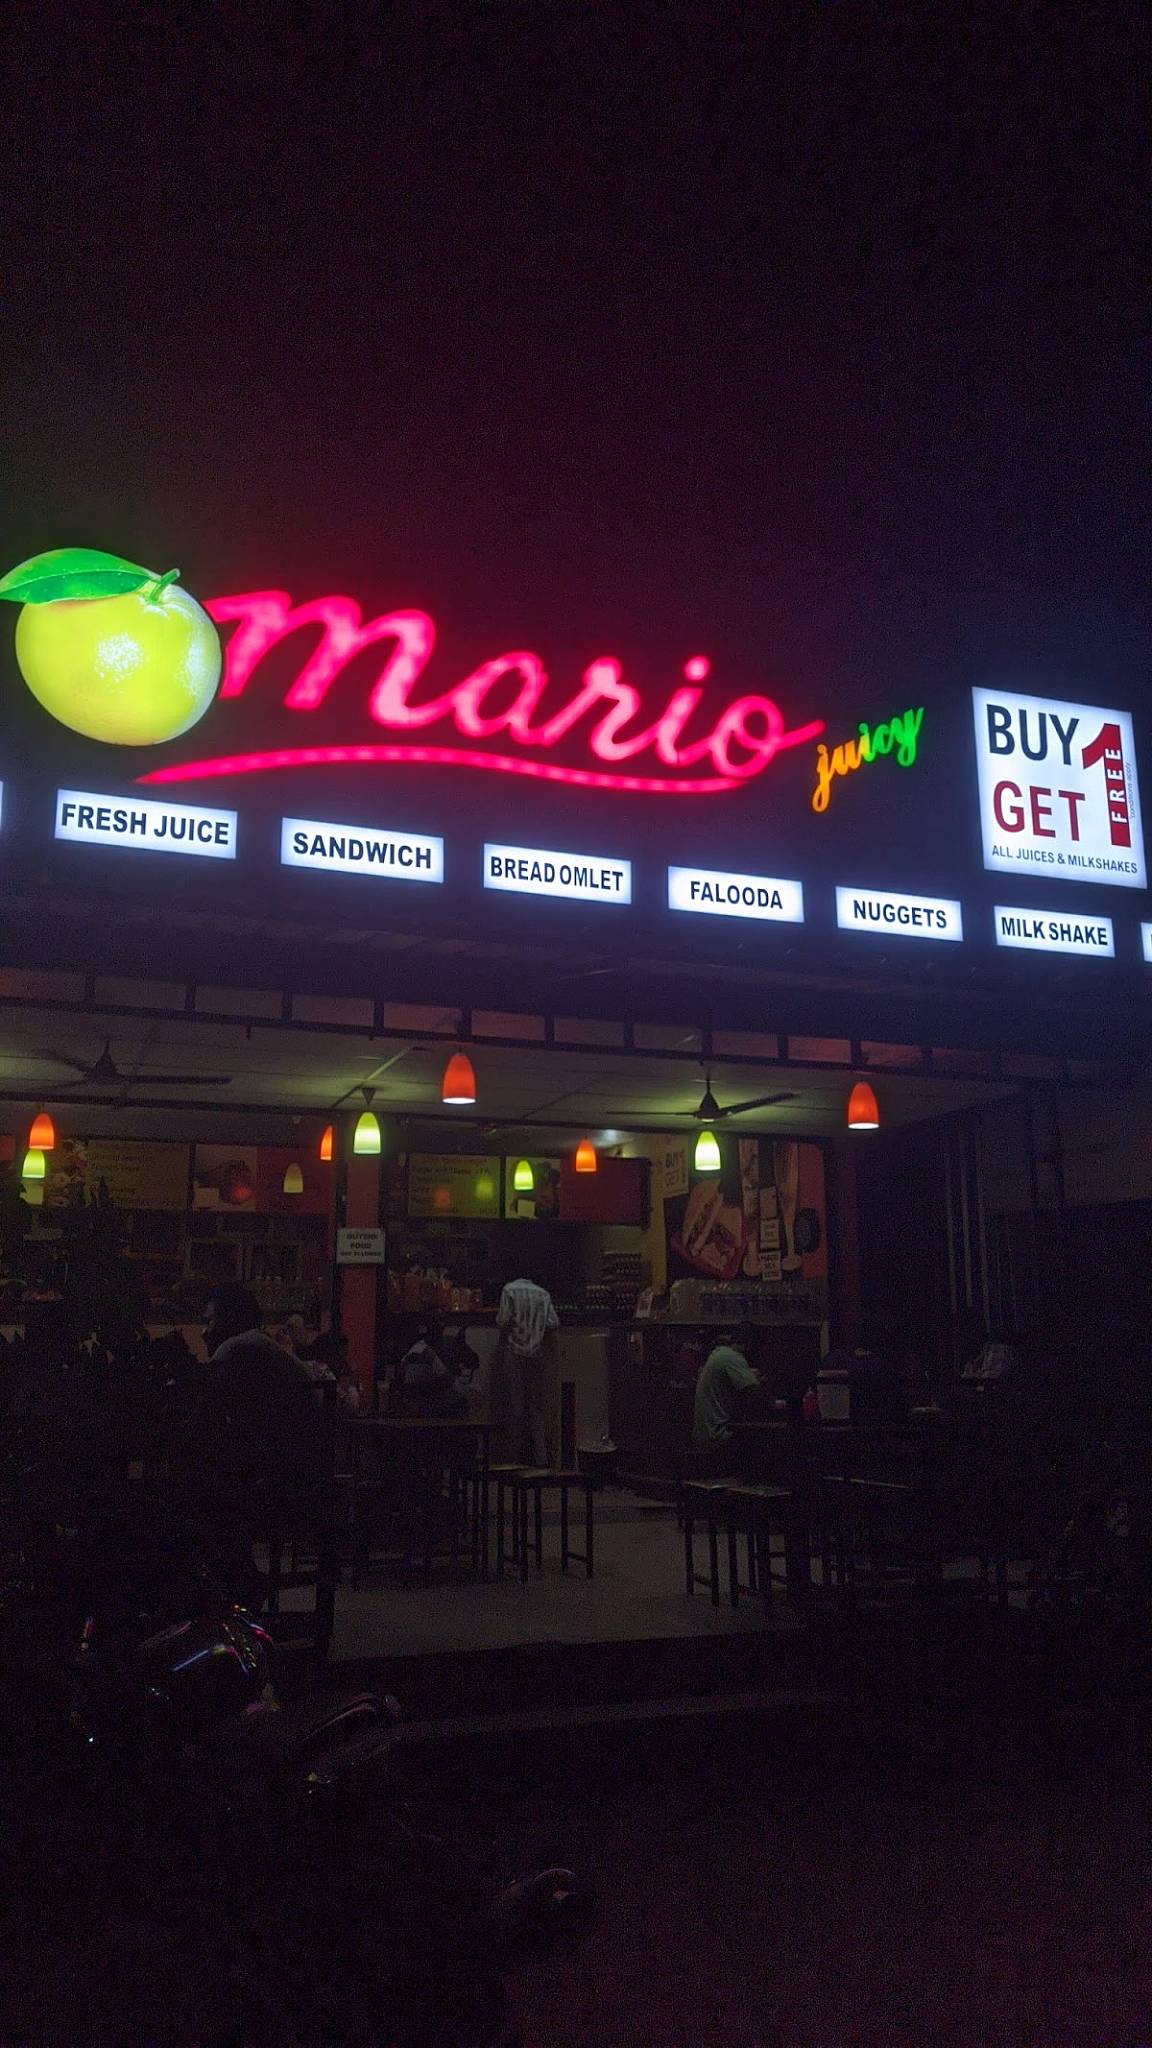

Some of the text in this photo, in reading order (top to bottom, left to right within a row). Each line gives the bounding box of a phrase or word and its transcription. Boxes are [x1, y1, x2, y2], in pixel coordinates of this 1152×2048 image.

[811, 706, 925, 813] juicy
[986, 704, 1131, 848] BUY 1
[1105, 748, 1127, 823] FREE
[61, 803, 229, 845] FRESH JUICE
[993, 780, 1086, 842] GET
[293, 832, 432, 869] SANDWICH
[992, 845, 1138, 873] ALL JUICES & MILKSHAKES
[690, 881, 783, 910] FALOODA
[853, 900, 947, 928] NUGGETS
[1001, 916, 1108, 945] MILK SHAKE
